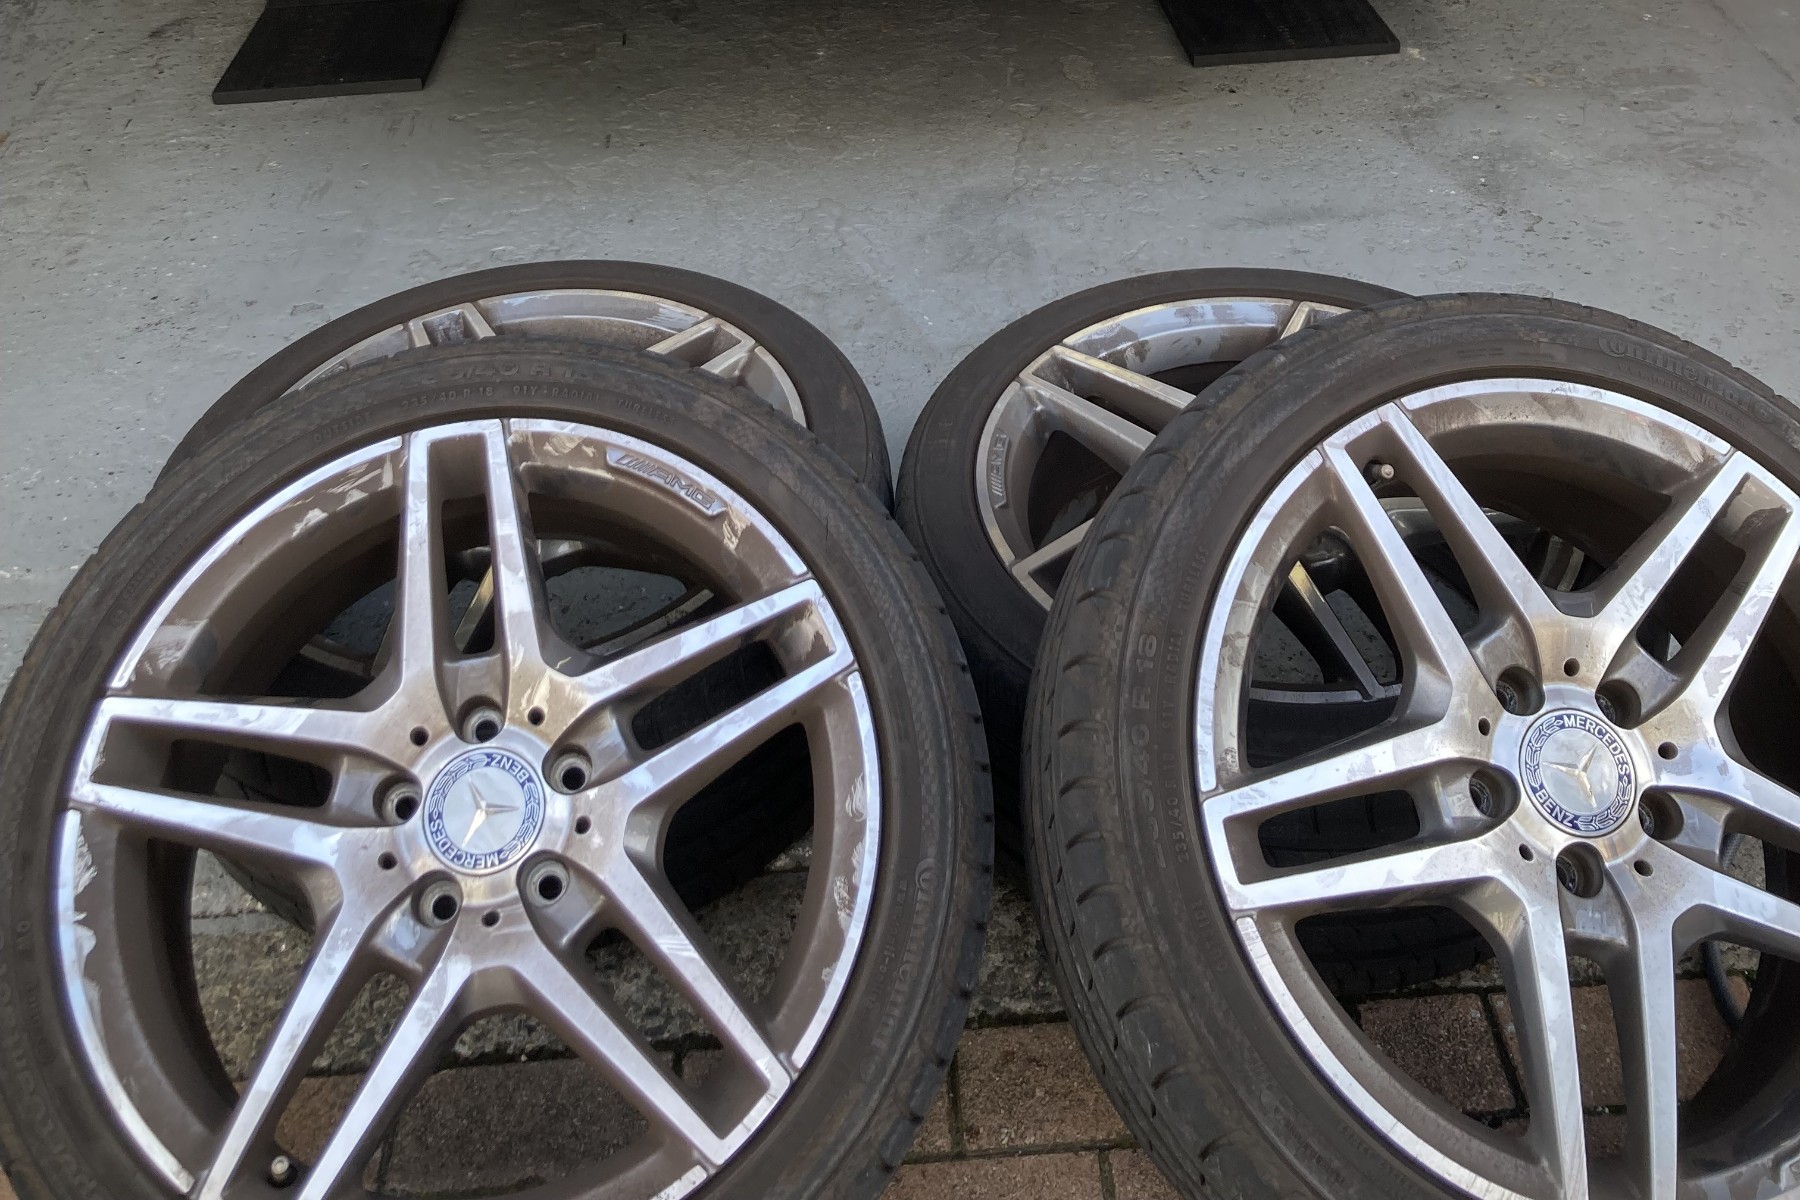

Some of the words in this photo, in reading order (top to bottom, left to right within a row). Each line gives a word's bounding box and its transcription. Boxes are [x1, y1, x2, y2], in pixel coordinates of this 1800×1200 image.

[1136, 633, 1158, 674] 18
[1562, 714, 1630, 776] MERCEDES
[490, 752, 529, 784] BENZ
[1535, 787, 1576, 828] BENZ
[430, 819, 500, 870] MERCEDES
